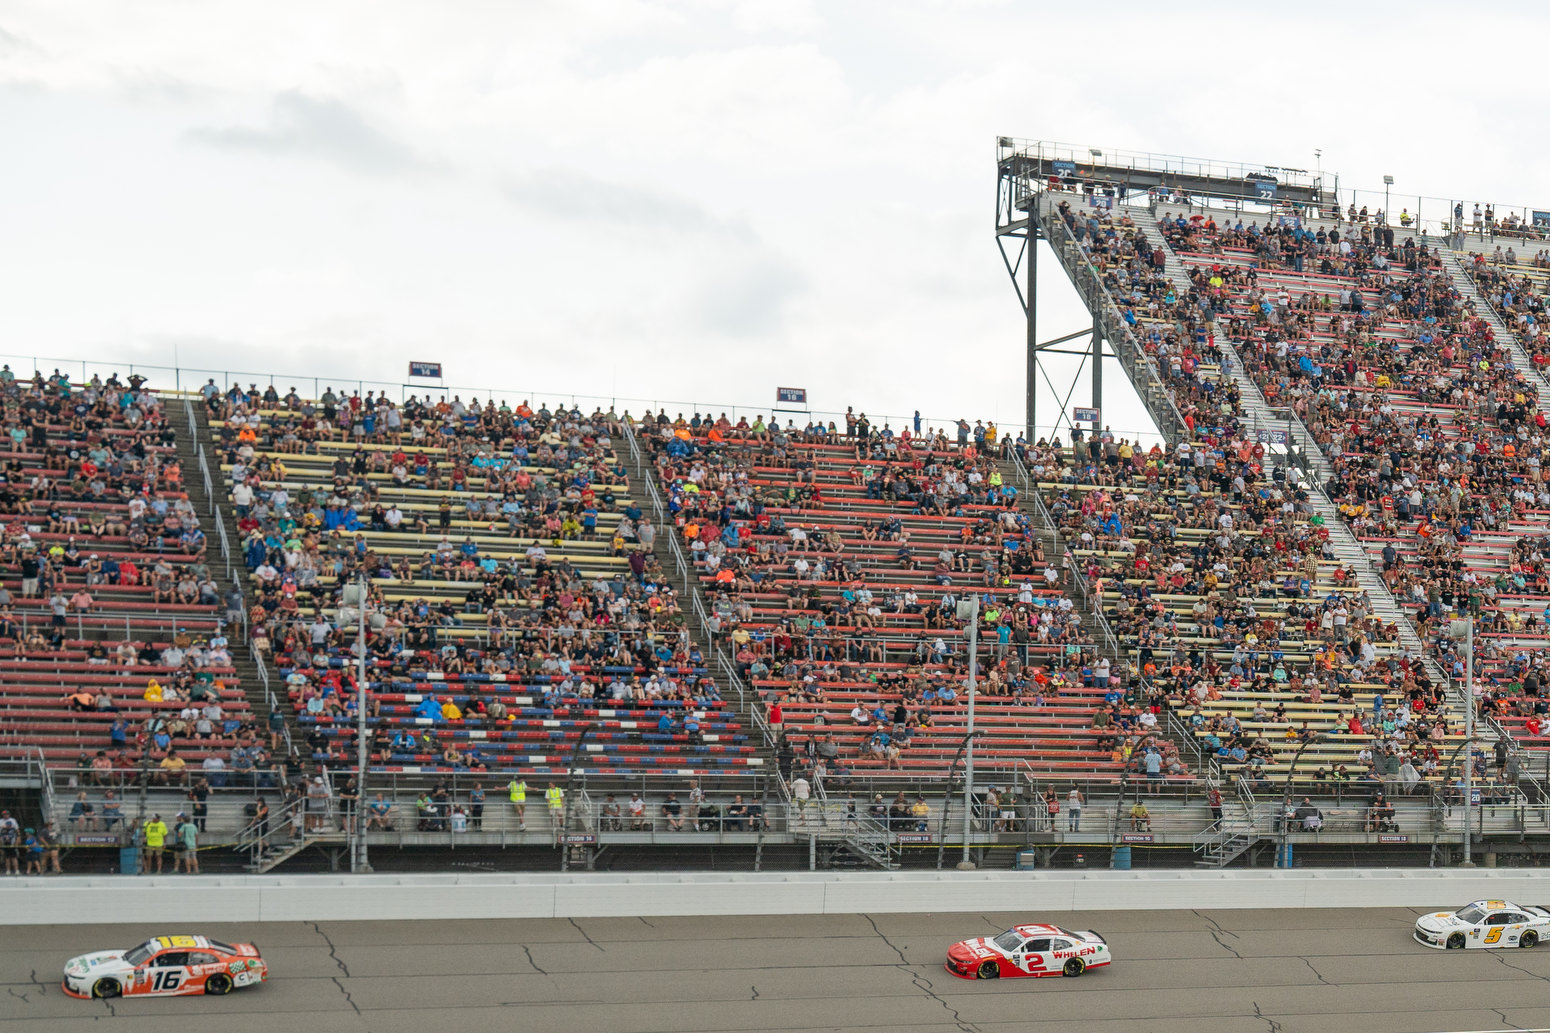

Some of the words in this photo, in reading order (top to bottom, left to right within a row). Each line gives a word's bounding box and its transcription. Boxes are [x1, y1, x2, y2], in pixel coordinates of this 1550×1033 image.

[1260, 190, 1273, 199] 22
[1471, 794, 1480, 802] 20
[1484, 927, 1505, 944] 5
[1052, 946, 1096, 959] WHELEN
[1025, 953, 1047, 972] 2
[152, 970, 183, 991] 16
